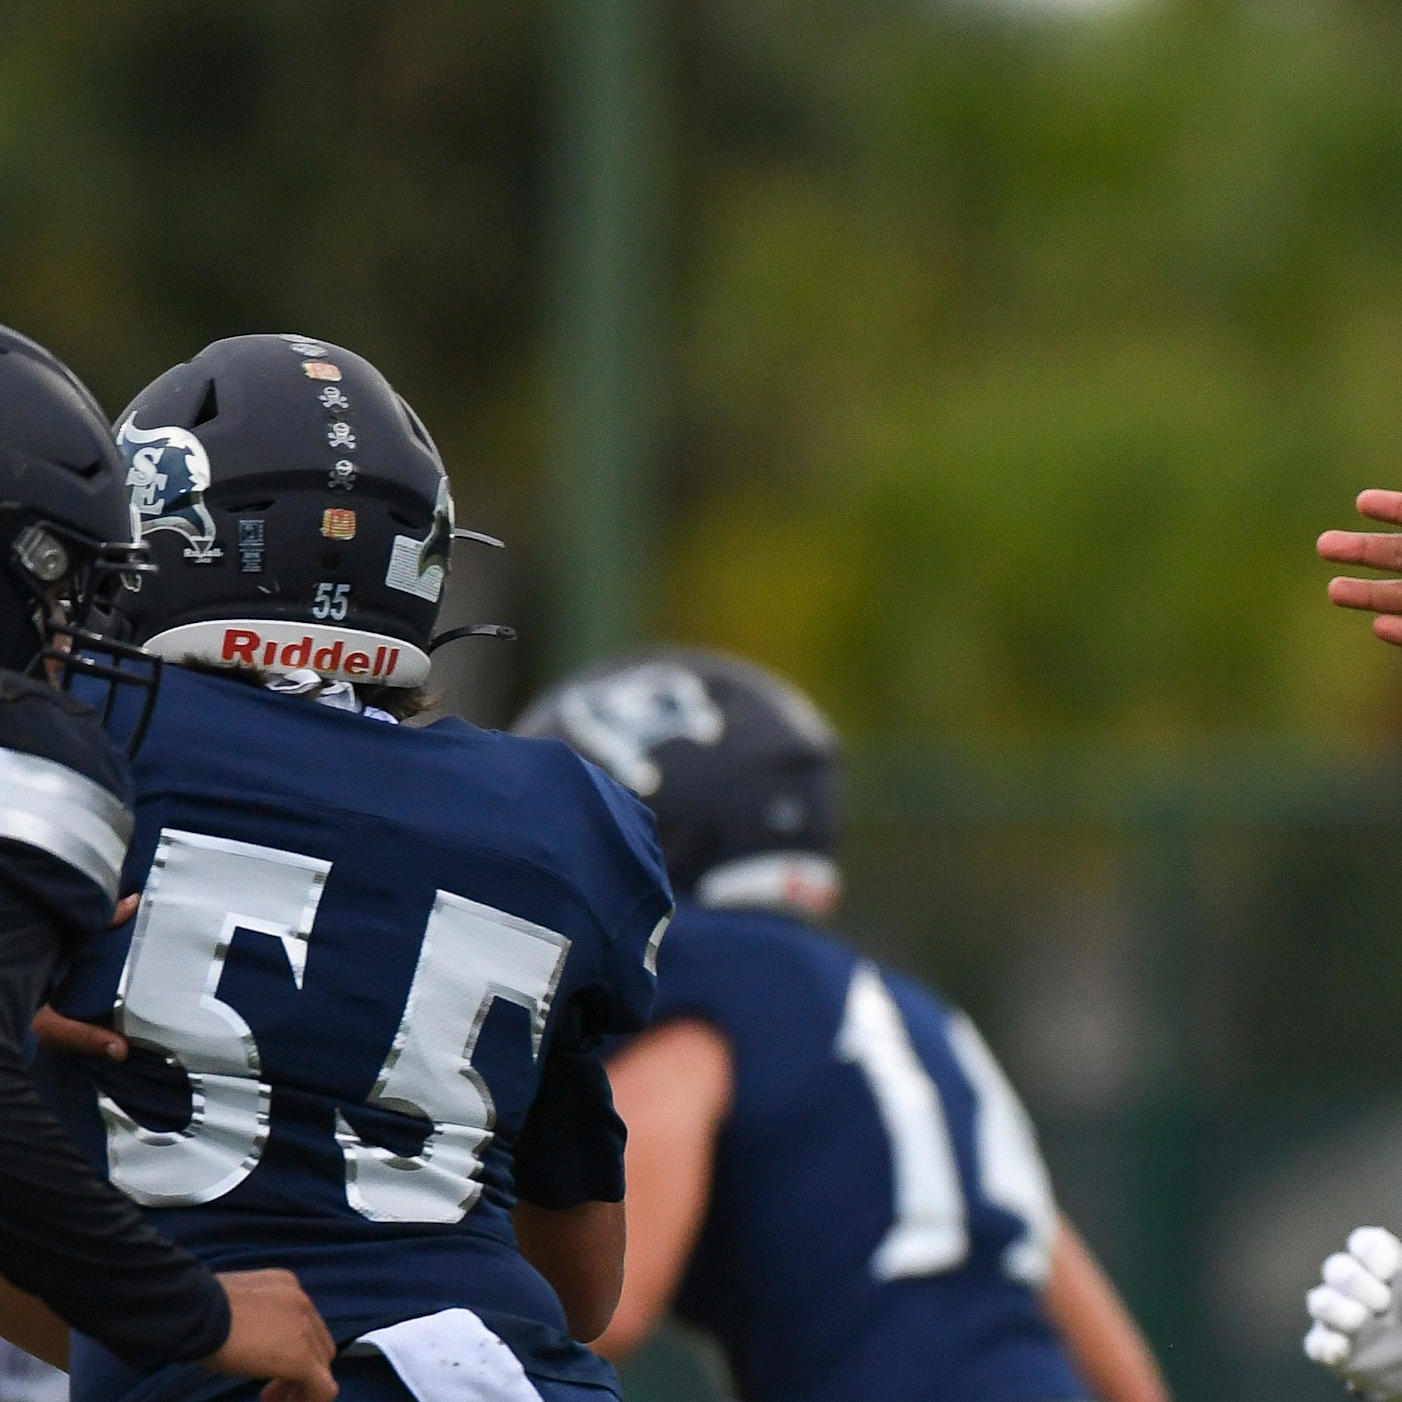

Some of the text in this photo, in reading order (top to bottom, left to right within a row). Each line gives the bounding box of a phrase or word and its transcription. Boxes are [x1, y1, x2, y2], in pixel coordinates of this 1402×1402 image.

[312, 582, 351, 620] 55
[220, 629, 401, 677] Riddell
[98, 828, 572, 1223] 55
